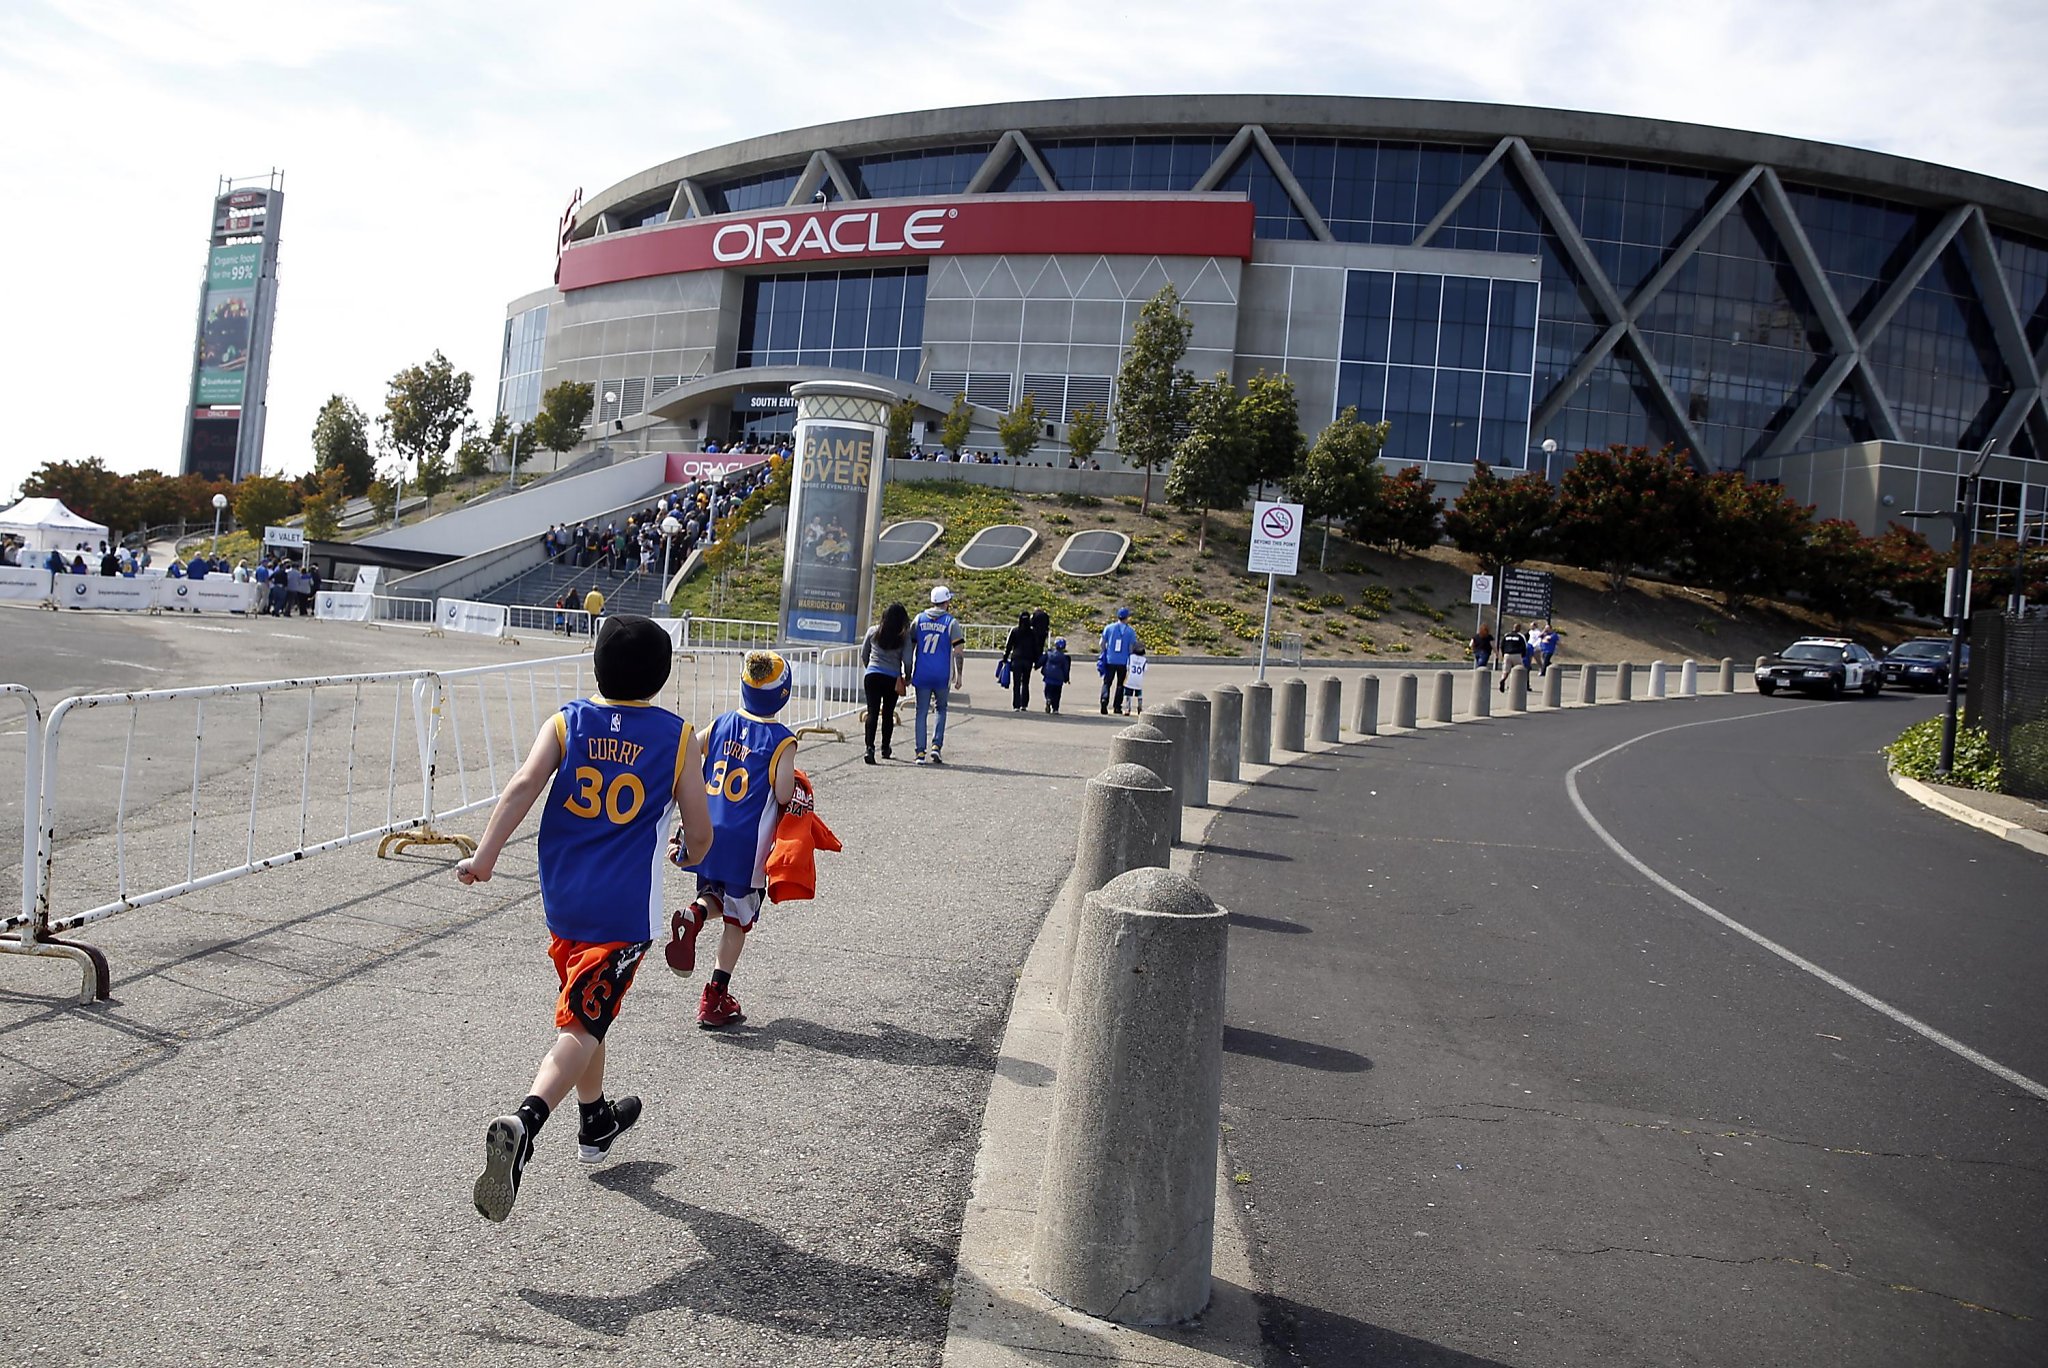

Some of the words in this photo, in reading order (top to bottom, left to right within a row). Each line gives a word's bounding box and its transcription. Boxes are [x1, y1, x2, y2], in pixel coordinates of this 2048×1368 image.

[231, 265, 253, 281] 99%
[750, 396, 778, 408] SOUTH
[804, 437, 871, 463] GAME
[801, 459, 869, 486] OVER
[279, 532, 300, 542] VALET
[798, 599, 846, 611] WARRIORS.COM
[922, 633, 940, 654] 11
[1131, 665, 1142, 675] 30
[588, 737, 644, 767] CURRY
[705, 759, 749, 803] 30
[564, 766, 646, 825] 30
